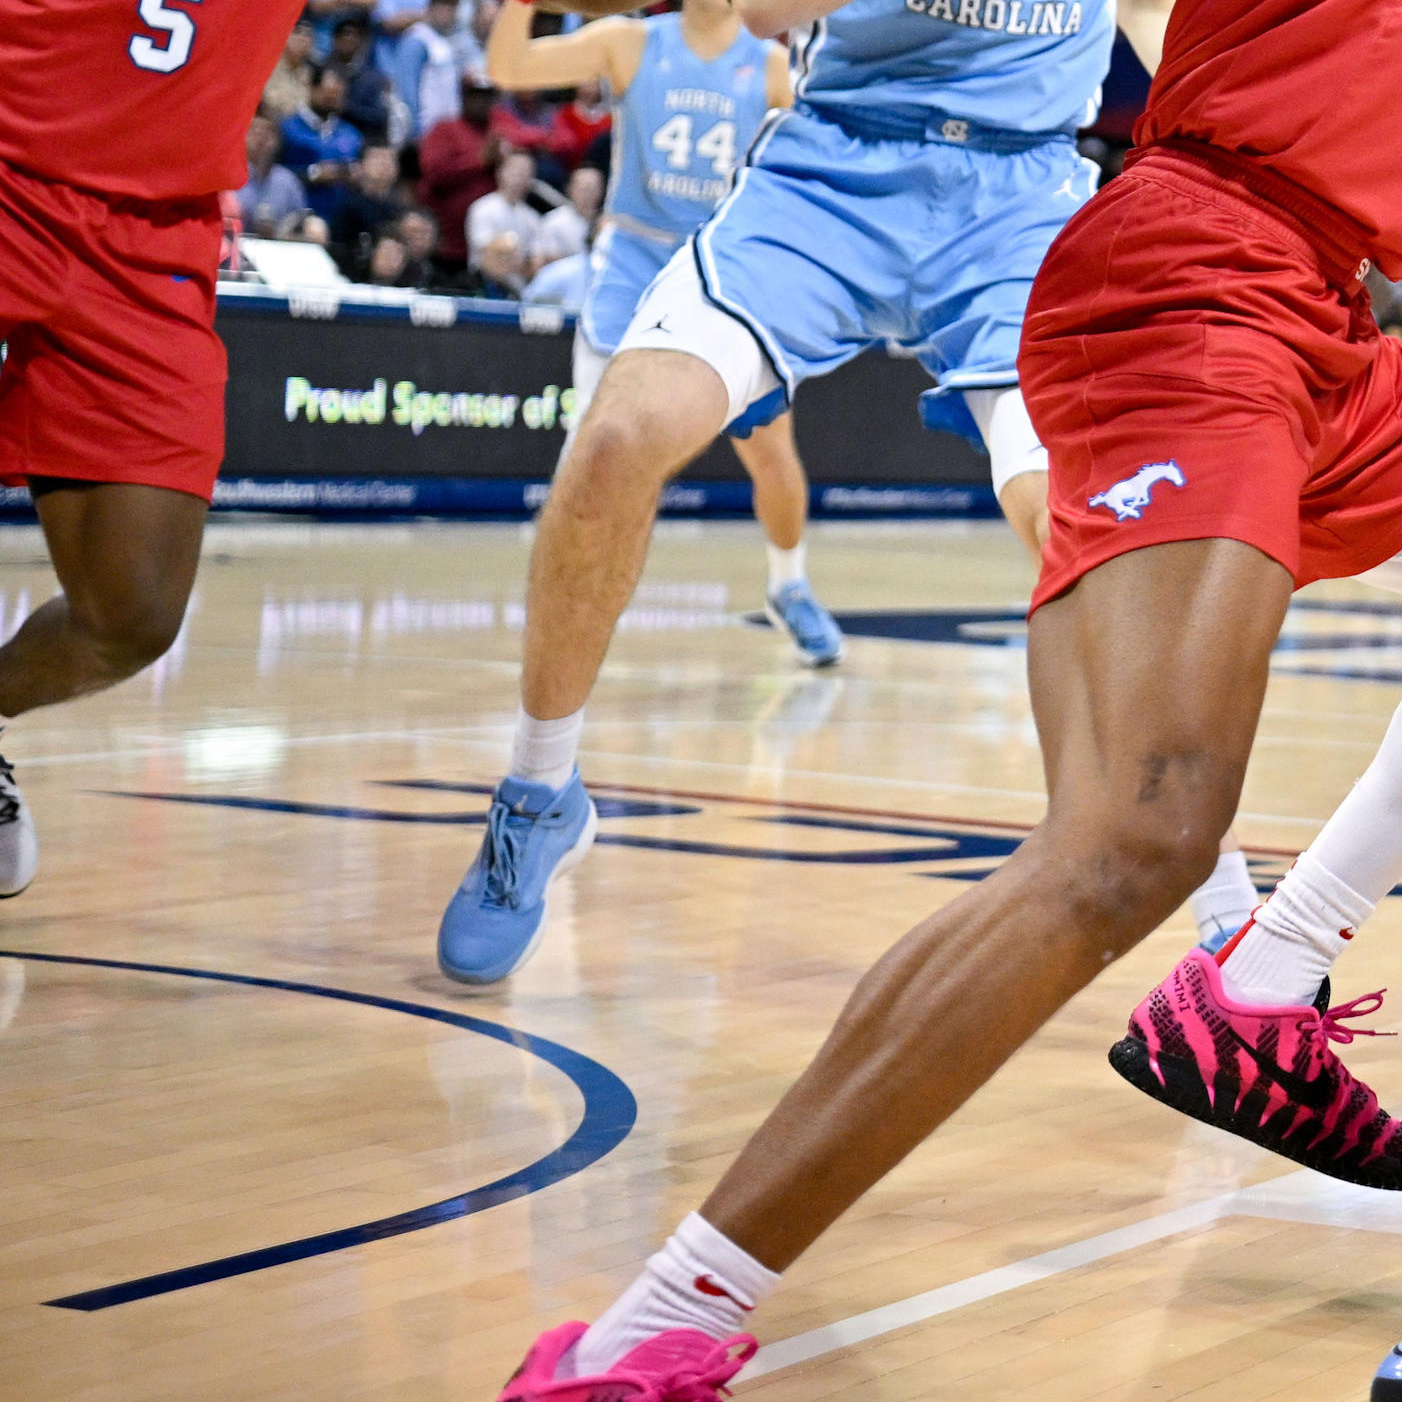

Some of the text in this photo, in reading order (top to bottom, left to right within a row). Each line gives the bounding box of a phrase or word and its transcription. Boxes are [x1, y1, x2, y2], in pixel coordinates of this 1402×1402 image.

[652, 113, 737, 175] 44
[285, 376, 388, 425] Proud
[392, 380, 518, 436] Sponsor
[522, 384, 560, 430] of
